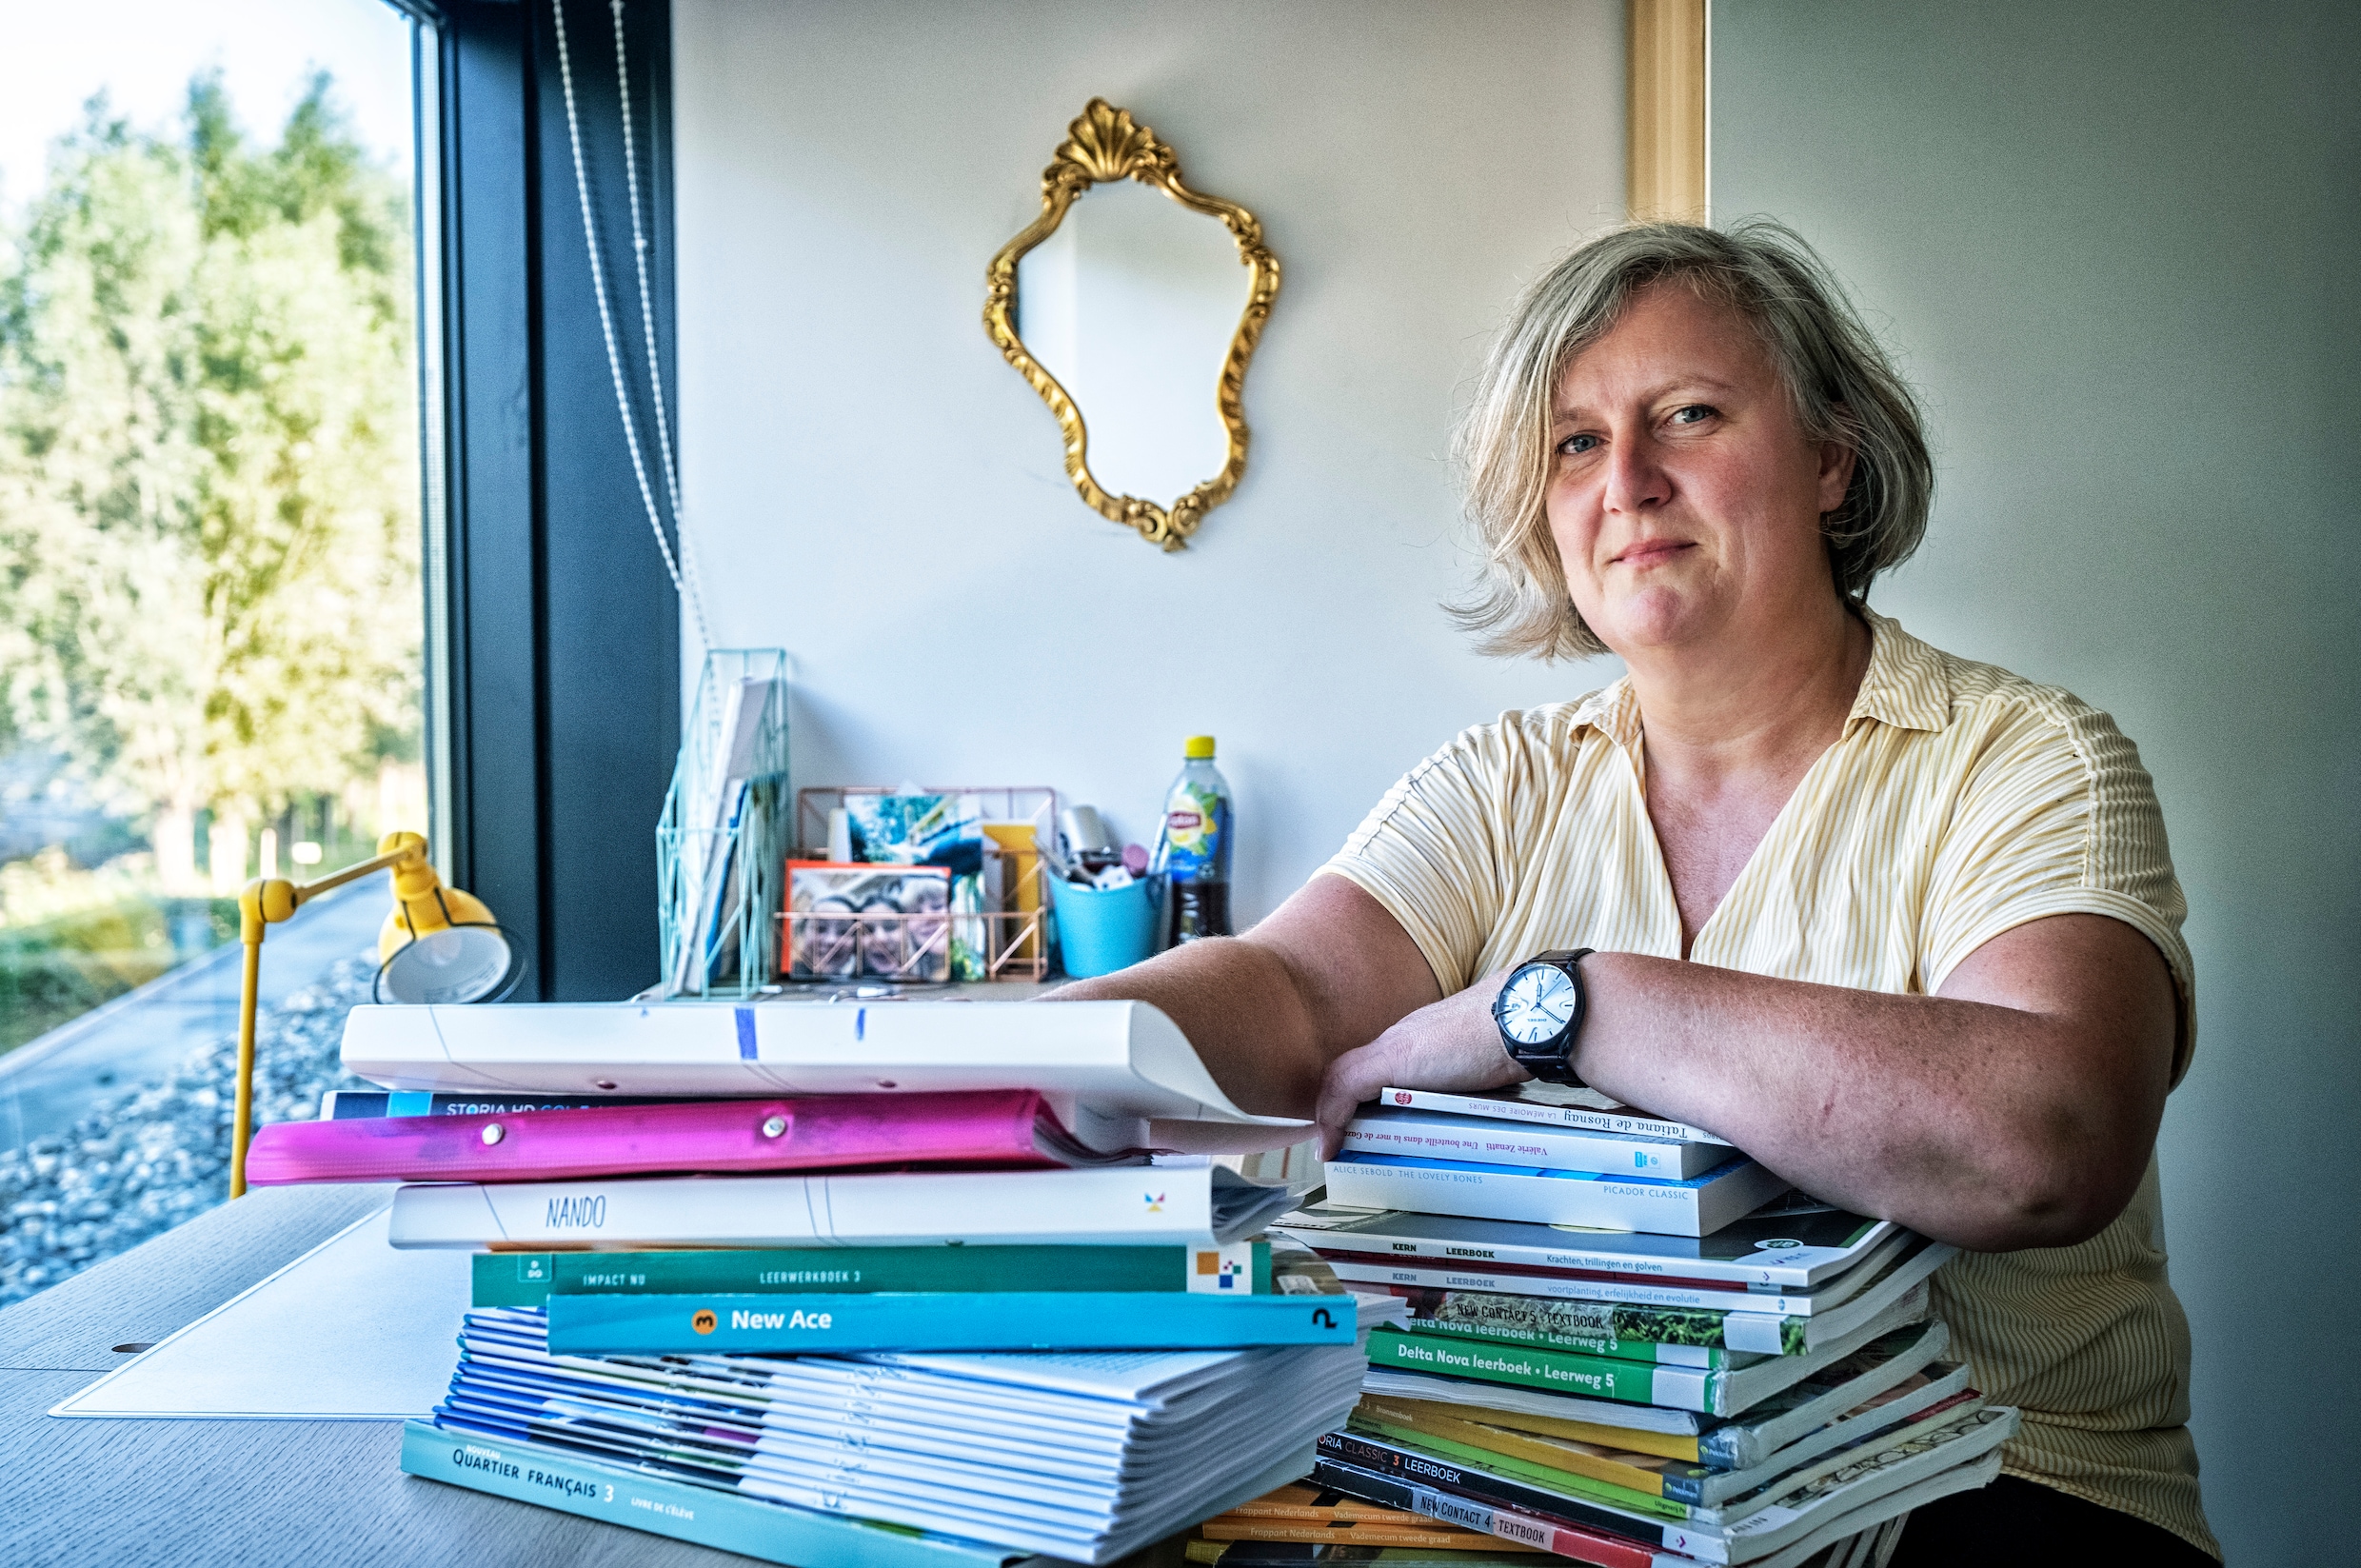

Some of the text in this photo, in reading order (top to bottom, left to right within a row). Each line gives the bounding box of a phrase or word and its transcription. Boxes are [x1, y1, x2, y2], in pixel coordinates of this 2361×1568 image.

[446, 1103, 506, 1116] STORIA
[1468, 1102, 1490, 1111] MURS
[1493, 1104, 1506, 1113] DES
[1509, 1107, 1544, 1119] MÉMOIRE
[1564, 1110, 1688, 1139] Tatiana de Rosnay
[1364, 1131, 1373, 1141] de
[1376, 1133, 1392, 1141] mer
[1394, 1134, 1400, 1142] la
[1404, 1135, 1422, 1144] dans
[1425, 1137, 1459, 1147] bouteille
[1462, 1141, 1478, 1150] Une
[1486, 1142, 1548, 1156] Valérie Zenatti
[1333, 1165, 1393, 1177] ALICE SEBOLD
[1399, 1170, 1483, 1184] THE LOVELY BONES
[1603, 1185, 1688, 1200] PICADOR CLASSIC
[546, 1195, 606, 1228] NANDO
[1392, 1243, 1417, 1252] KERN
[1446, 1247, 1495, 1259] LEERBOEK
[1547, 1254, 1662, 1272] Krachten, trillingen en golven
[583, 1274, 646, 1285] IMPACT NU
[760, 1270, 861, 1283] LEERWERKBOEK 3
[1392, 1272, 1495, 1287] KERN LEERBOEK
[1548, 1285, 1700, 1303] voortplanting, erfelijkheid en evolutie
[731, 1309, 832, 1329] New Ace
[1457, 1303, 1604, 1329] NEW CONTACT 5 TEXTBOOK
[1410, 1318, 1618, 1353] elta Nova leerboek Leerweg 5
[1399, 1343, 1615, 1390] Delta Nova leerboek Leerweg 5
[1376, 1404, 1413, 1421] Bronnenboek
[466, 1443, 501, 1459] NOUVEAU
[1318, 1434, 1460, 1484] ORIA CLASSIC 3 LEERBOEK
[452, 1448, 614, 1502] QUARTIER FRANÇAIS 3
[631, 1497, 653, 1511] LIVRE
[654, 1502, 665, 1514] DE
[1236, 1507, 1319, 1518] Frappant Nederlands
[1334, 1511, 1434, 1524] Vademecum tweede graad
[1420, 1496, 1440, 1513] NEW
[1441, 1502, 1481, 1525] CONTACT
[1484, 1515, 1491, 1528] 4
[1498, 1519, 1545, 1543] TEXTBOOK
[1250, 1527, 1335, 1539] Frappant Nederlands
[1350, 1531, 1451, 1544] Vademecum tweede graad
